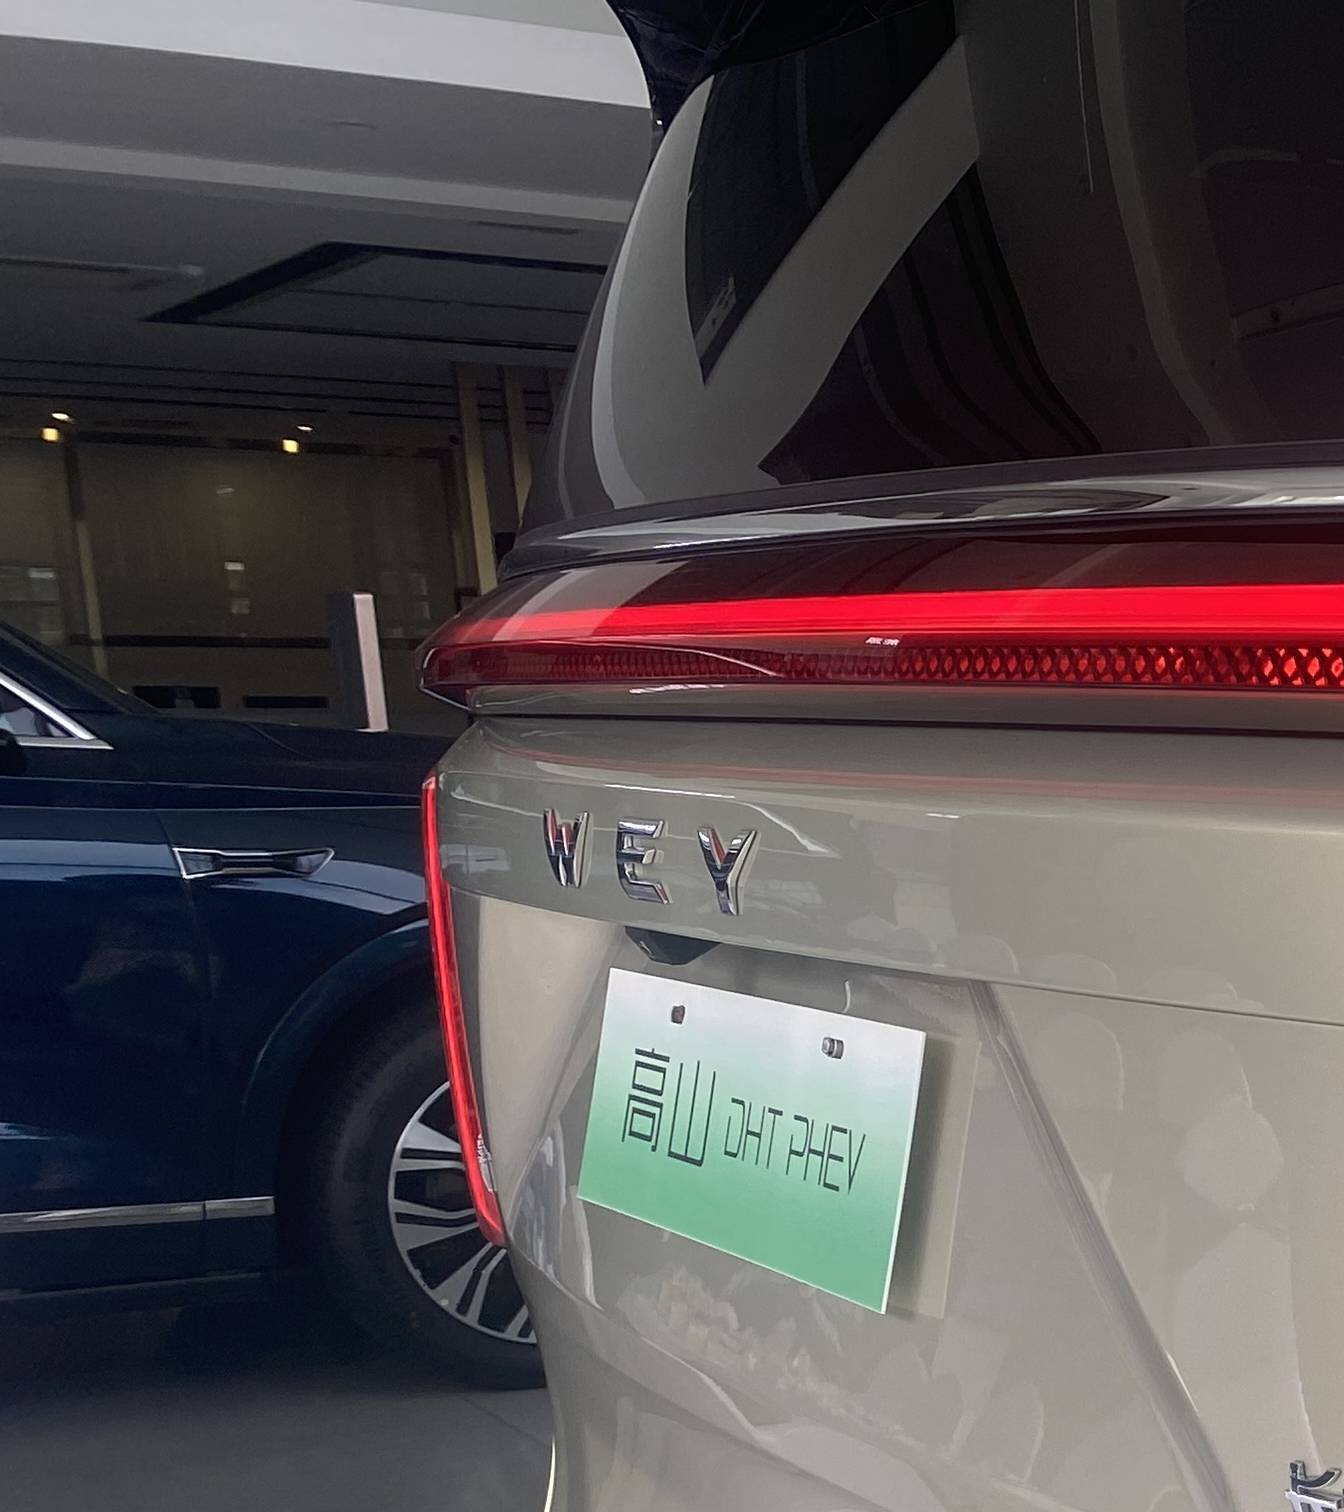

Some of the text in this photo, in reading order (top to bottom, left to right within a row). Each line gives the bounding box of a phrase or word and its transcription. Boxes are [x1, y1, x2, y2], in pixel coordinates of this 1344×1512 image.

[543, 808, 760, 916] WEY
[621, 1046, 867, 1195] 高山 DHT PHEV
